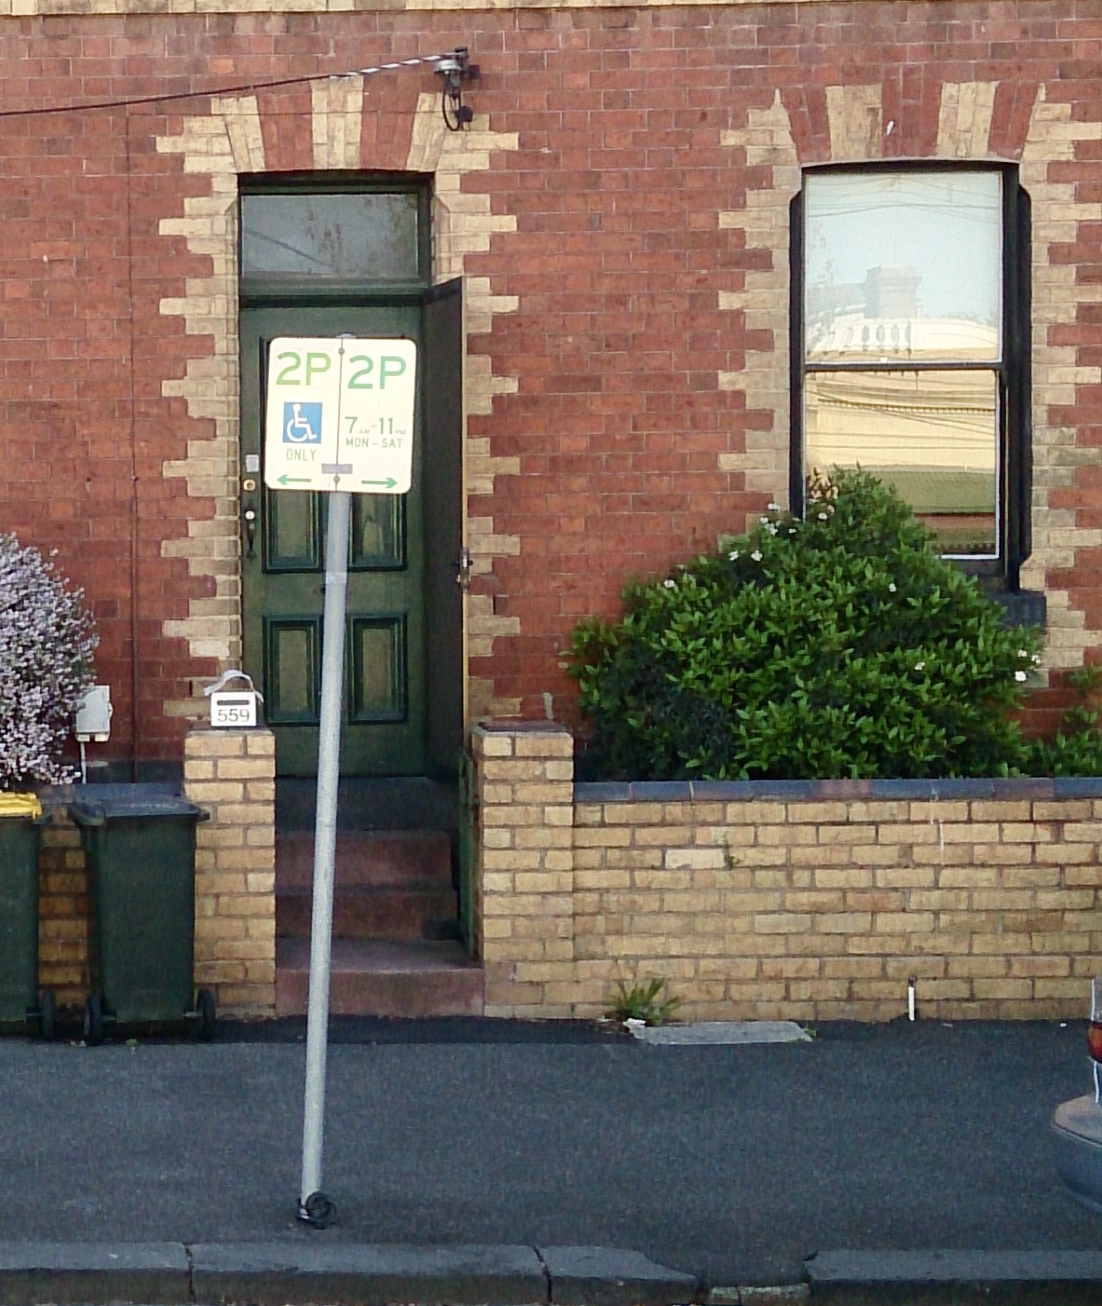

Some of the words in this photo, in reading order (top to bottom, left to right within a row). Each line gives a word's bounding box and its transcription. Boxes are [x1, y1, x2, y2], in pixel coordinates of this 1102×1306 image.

[275, 351, 332, 386] 2P
[347, 355, 407, 390] 2P
[345, 437, 369, 448] MON
[381, 438, 403, 449] SAT
[286, 448, 317, 462] ONLY
[217, 708, 250, 723] 559
